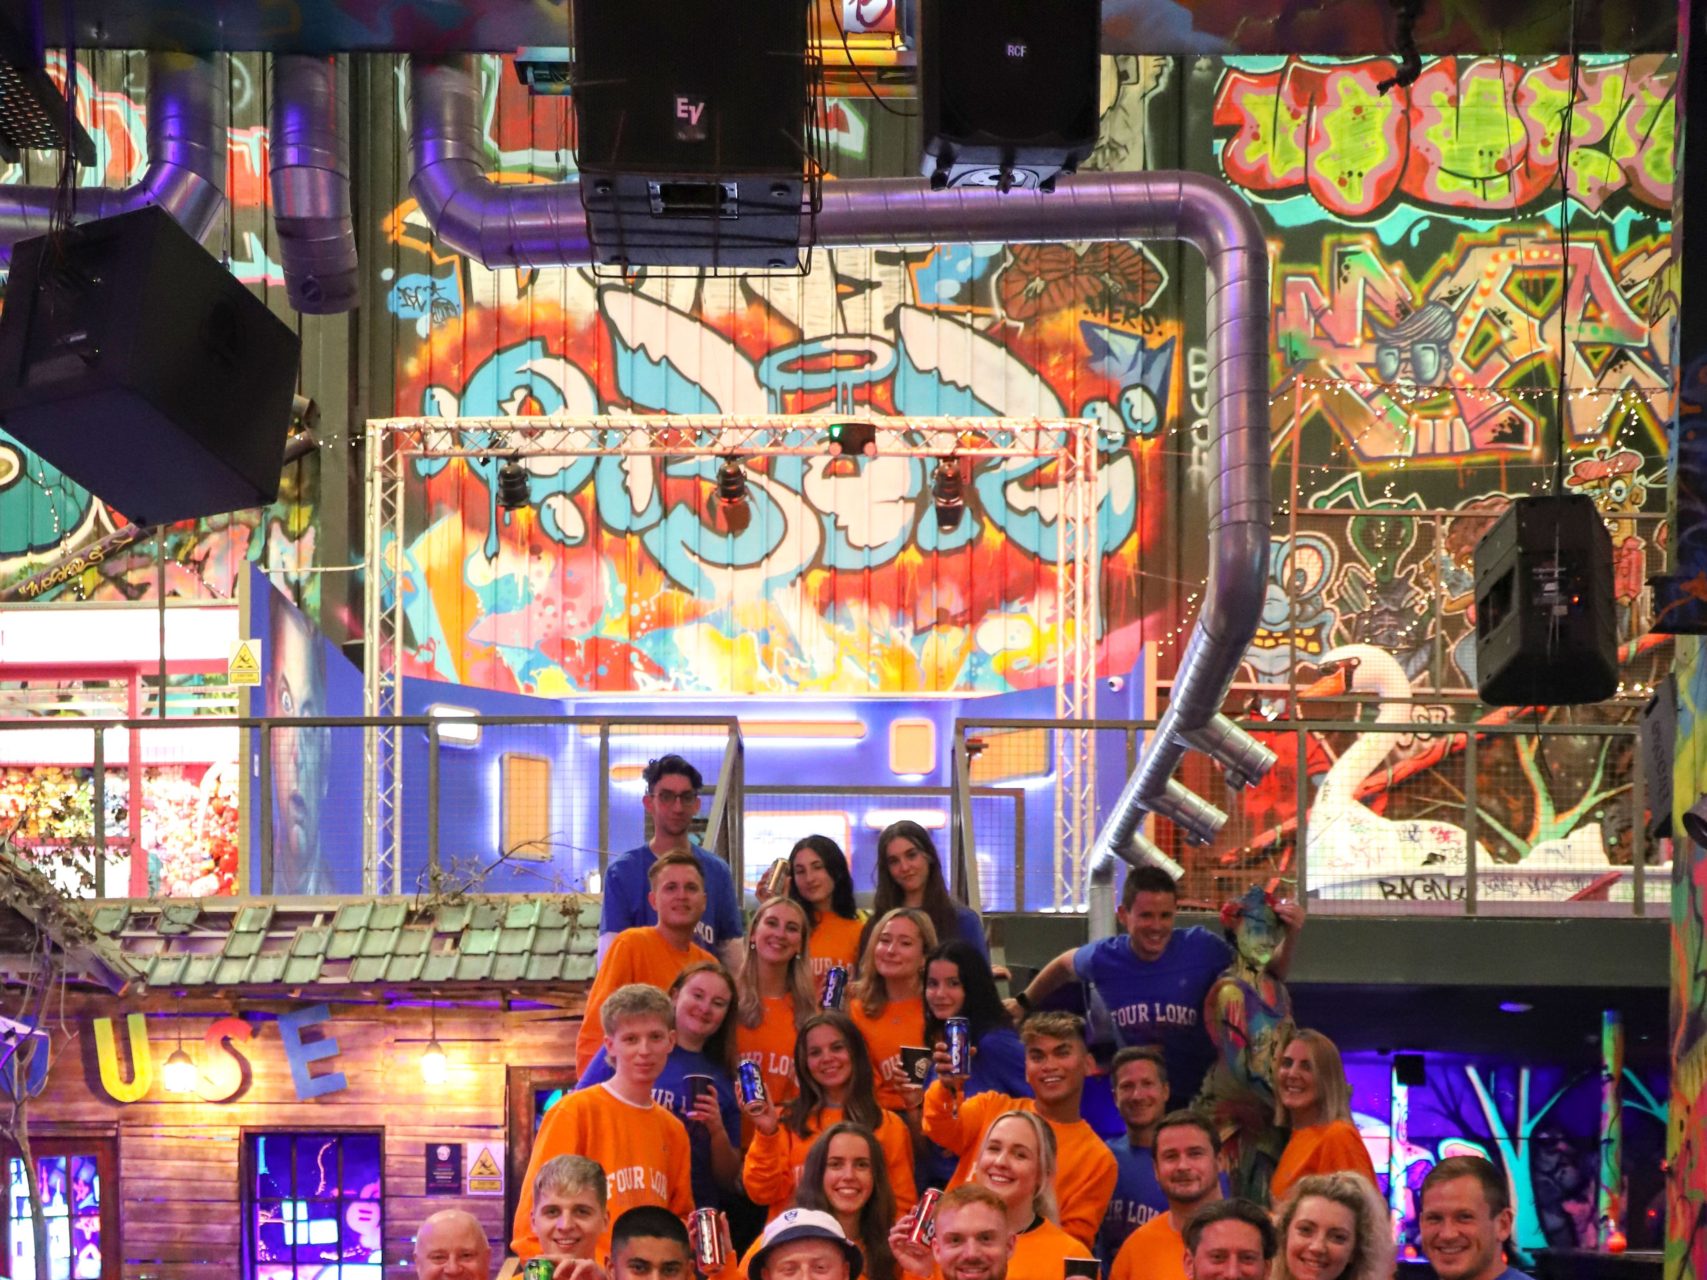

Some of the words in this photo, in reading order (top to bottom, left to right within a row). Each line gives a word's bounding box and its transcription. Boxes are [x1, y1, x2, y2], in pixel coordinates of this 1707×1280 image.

[1007, 44, 1027, 57] RCF
[1110, 1003, 1149, 1028] FOUR
[1154, 1002, 1198, 1027] LOKO
[606, 1166, 646, 1201] FOUR
